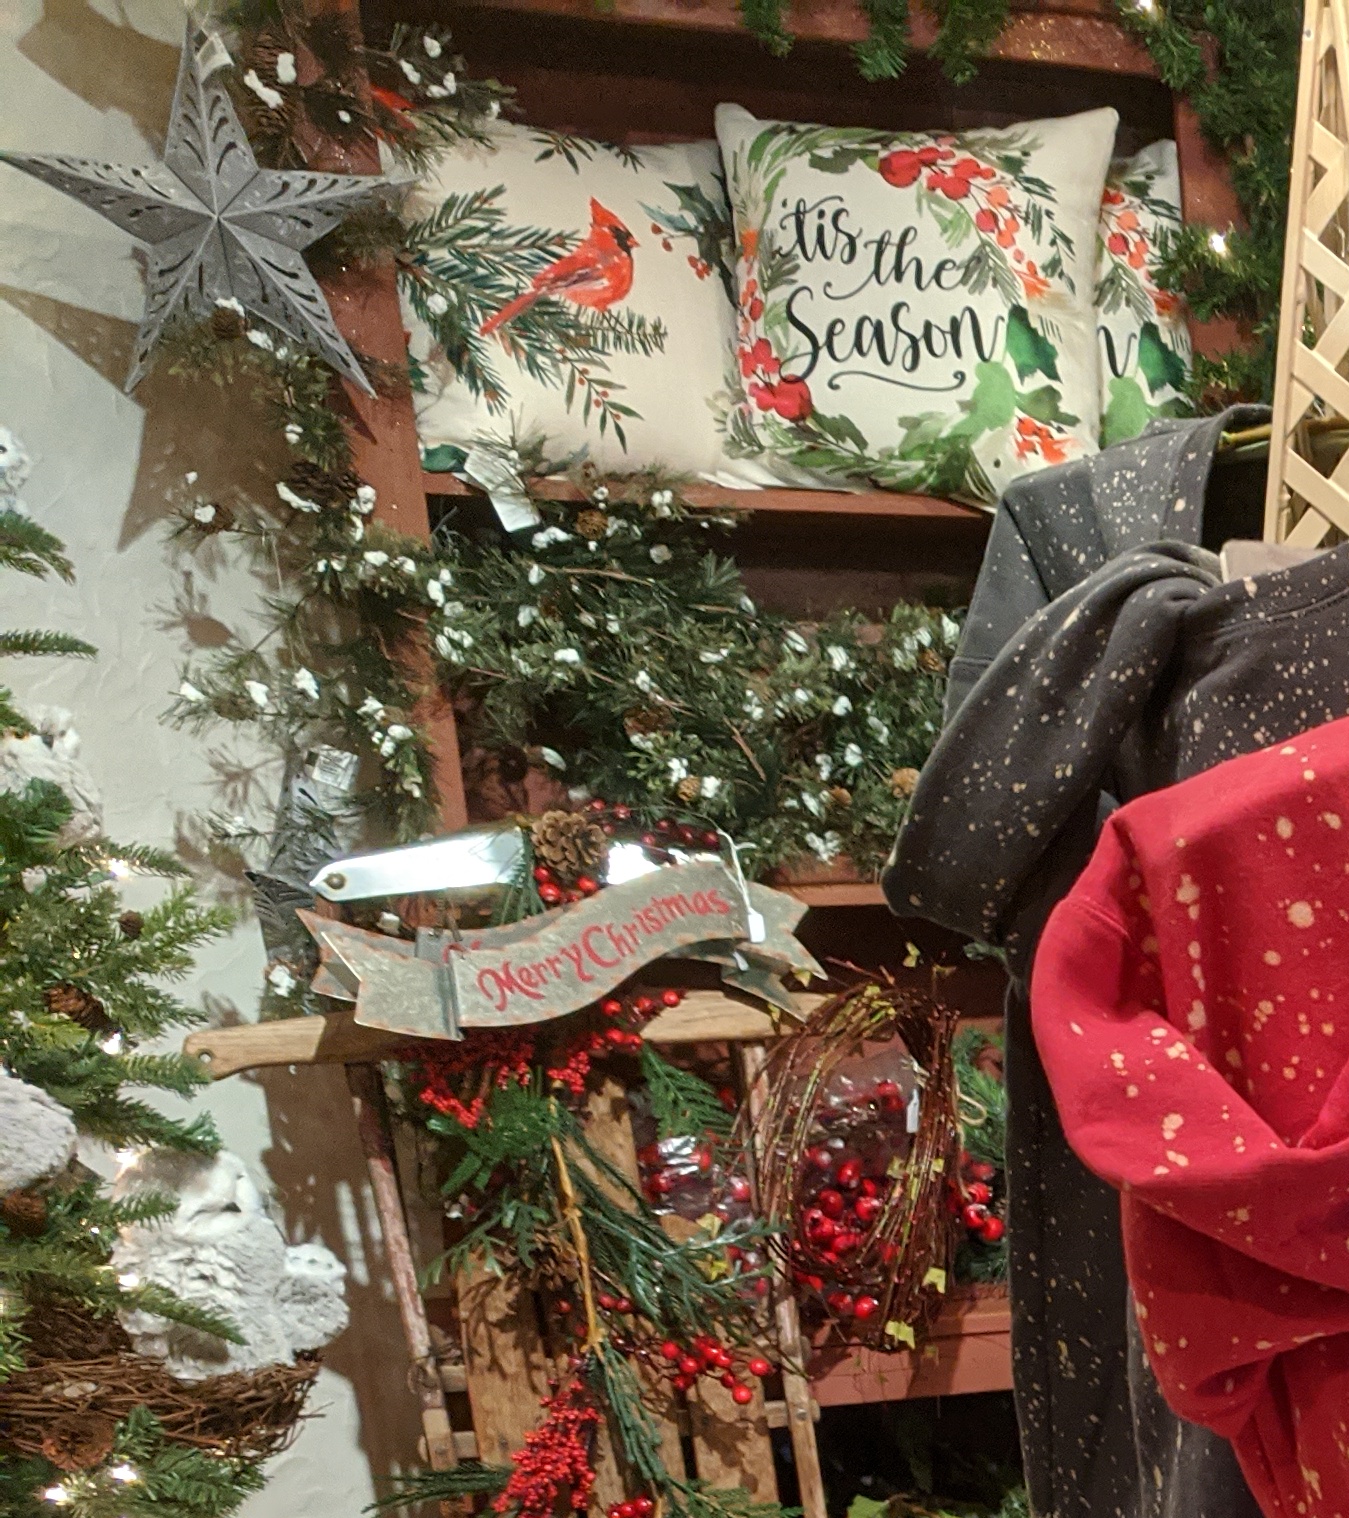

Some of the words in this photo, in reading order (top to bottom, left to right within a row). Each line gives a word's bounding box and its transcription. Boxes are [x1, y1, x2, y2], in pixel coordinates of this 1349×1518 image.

[823, 225, 972, 301] the
[778, 285, 1006, 384] Season
[477, 942, 592, 1012] Merry
[579, 888, 731, 969] Christmas
